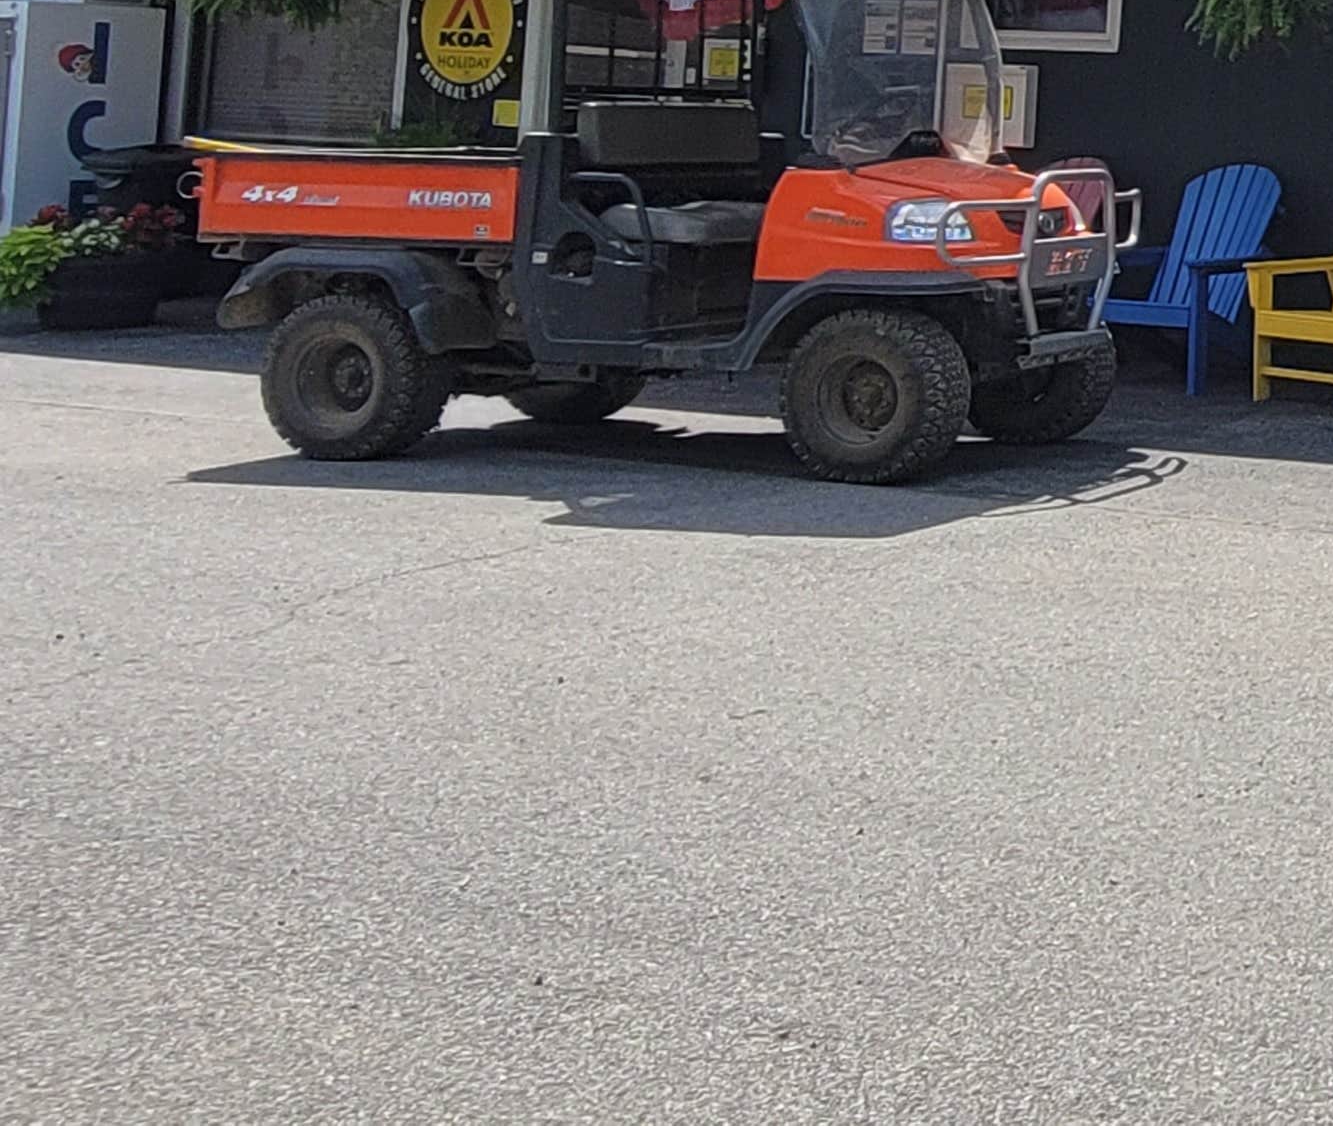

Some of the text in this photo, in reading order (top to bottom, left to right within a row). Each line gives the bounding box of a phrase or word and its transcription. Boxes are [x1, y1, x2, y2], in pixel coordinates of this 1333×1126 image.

[438, 31, 494, 48] KOA
[437, 55, 492, 69] HOLIDAY
[419, 63, 507, 101] GENERAL STORE
[241, 185, 299, 203] 4x4
[408, 189, 492, 209] KUBOTA
